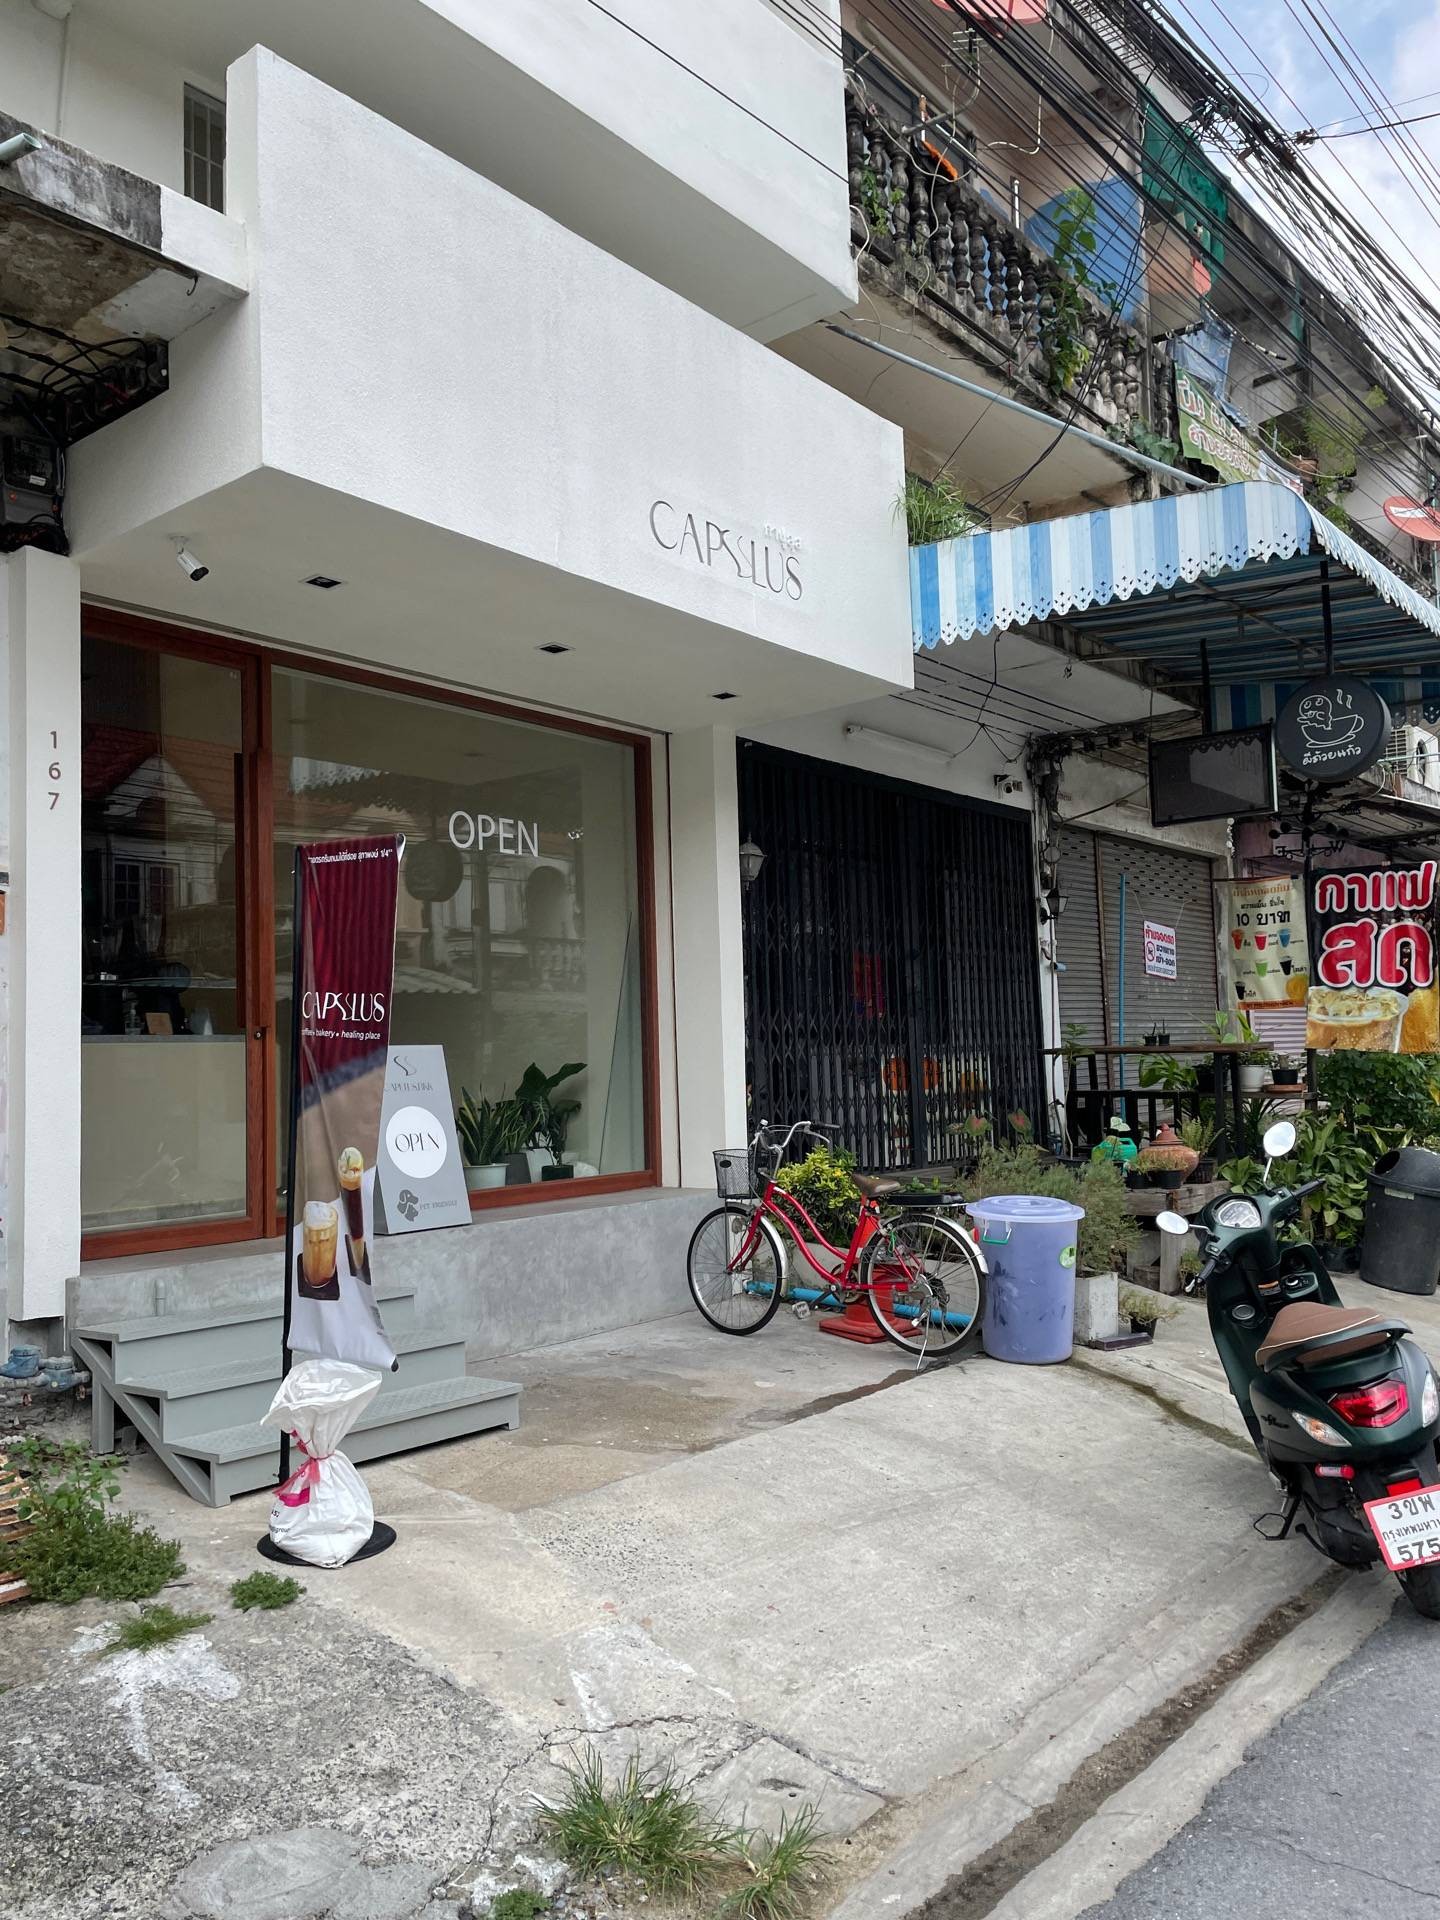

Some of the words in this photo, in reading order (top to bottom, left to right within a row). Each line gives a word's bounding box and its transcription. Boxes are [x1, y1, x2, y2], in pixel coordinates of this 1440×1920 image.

[448, 810, 539, 858] OPEN
[1315, 860, 1437, 914] กาแฟ
[1236, 912, 1250, 927] 10
[1256, 910, 1291, 926] บาท
[1318, 917, 1434, 988] สด
[315, 1028, 336, 1039] bakery
[341, 1030, 364, 1041] healing
[364, 1031, 381, 1041] place
